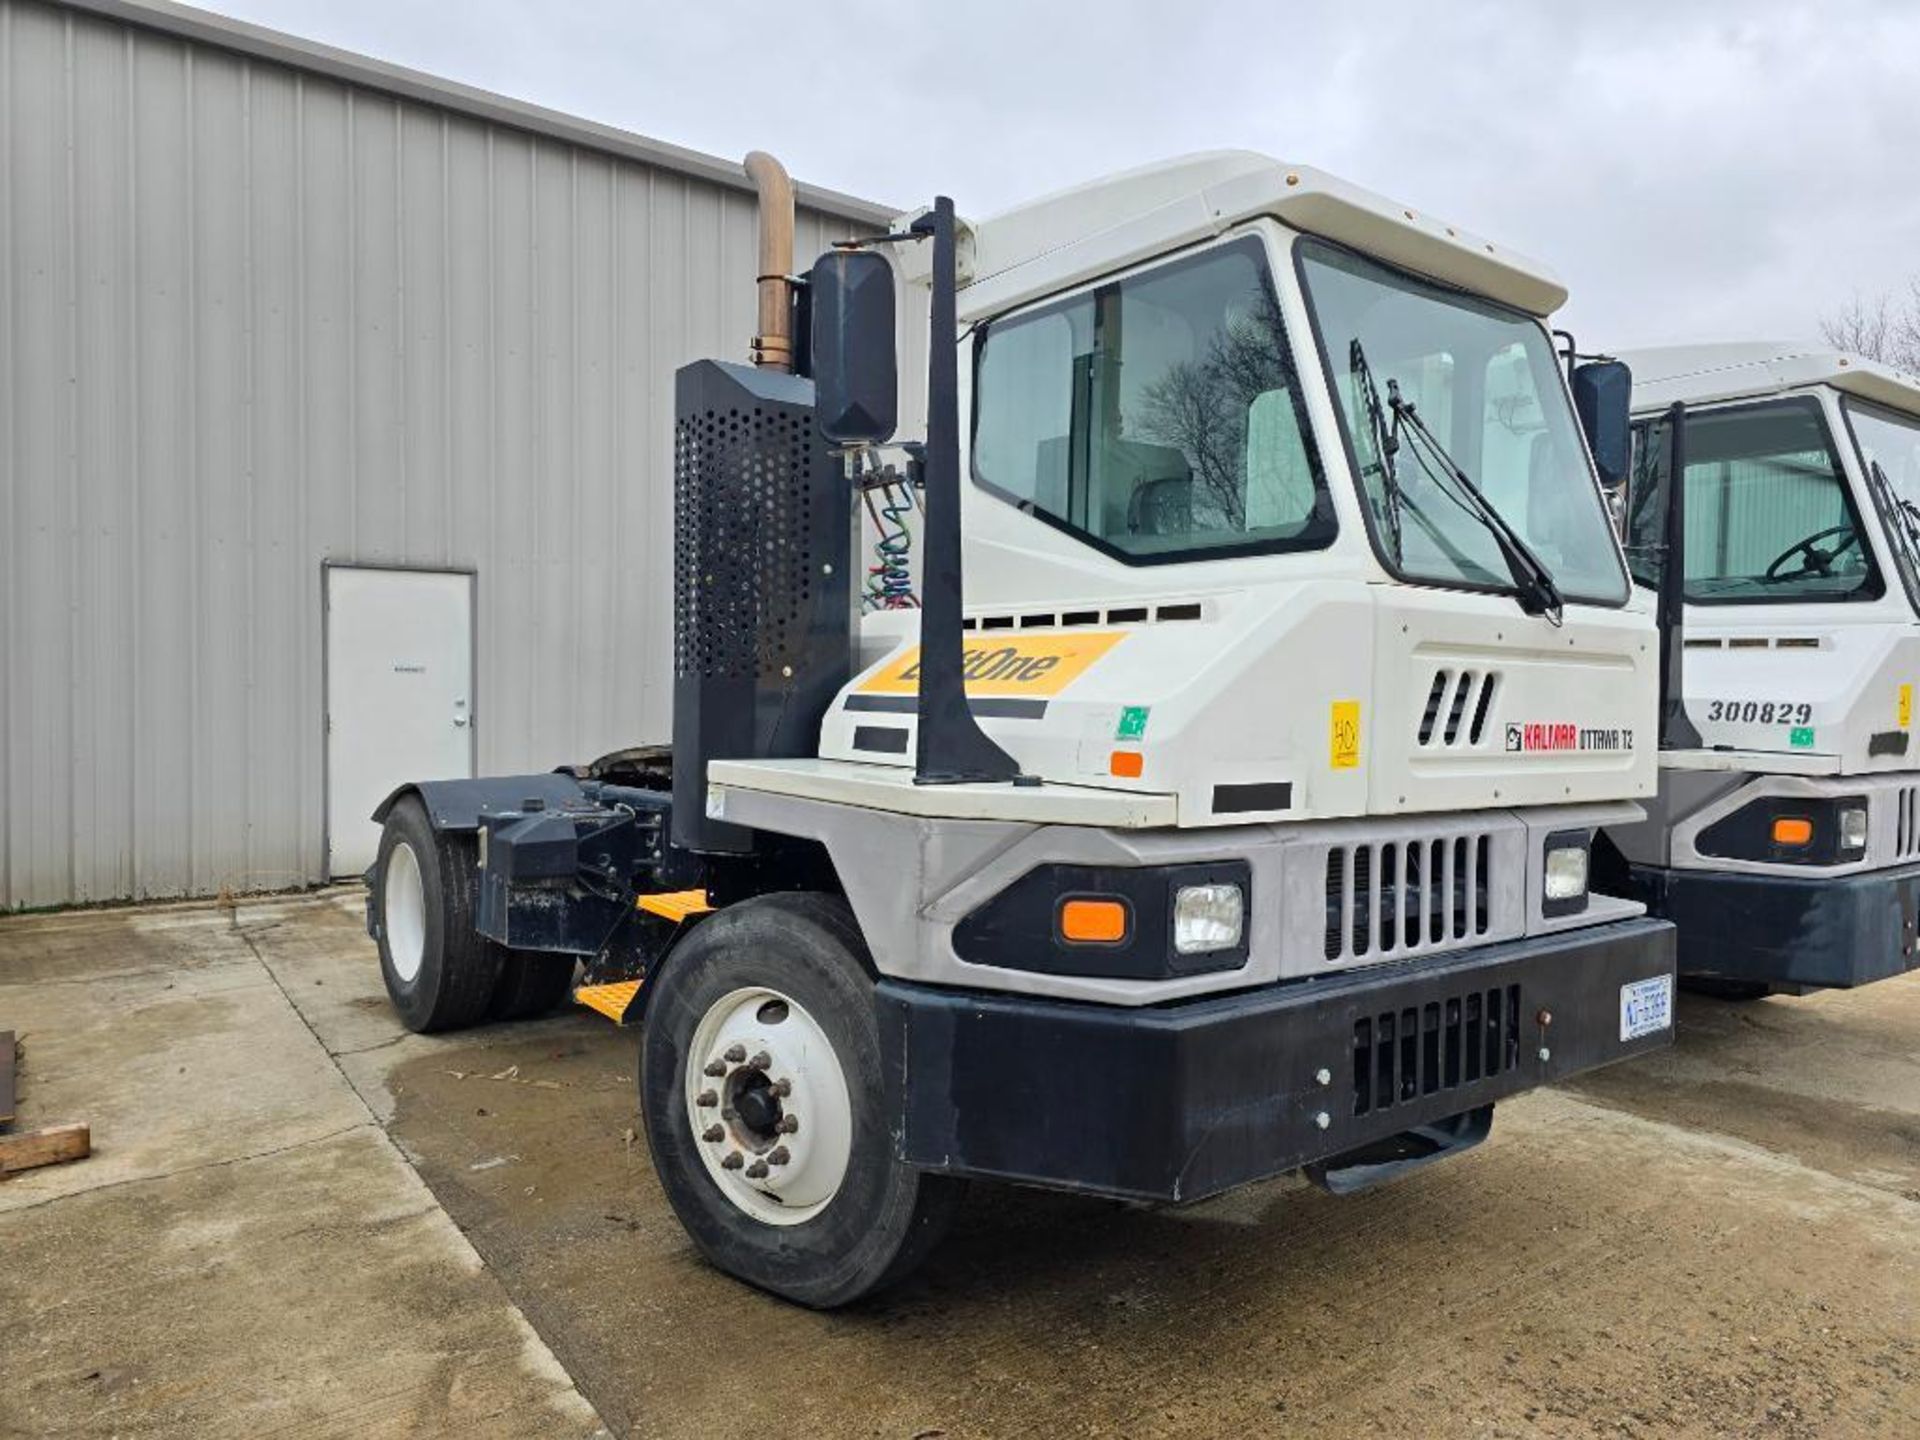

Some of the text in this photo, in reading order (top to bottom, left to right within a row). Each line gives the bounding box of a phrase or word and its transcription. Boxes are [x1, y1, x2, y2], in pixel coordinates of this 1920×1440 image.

[1708, 700, 1812, 724] 300829
[1524, 724, 1633, 750] KALMAR OTTAWA T2
